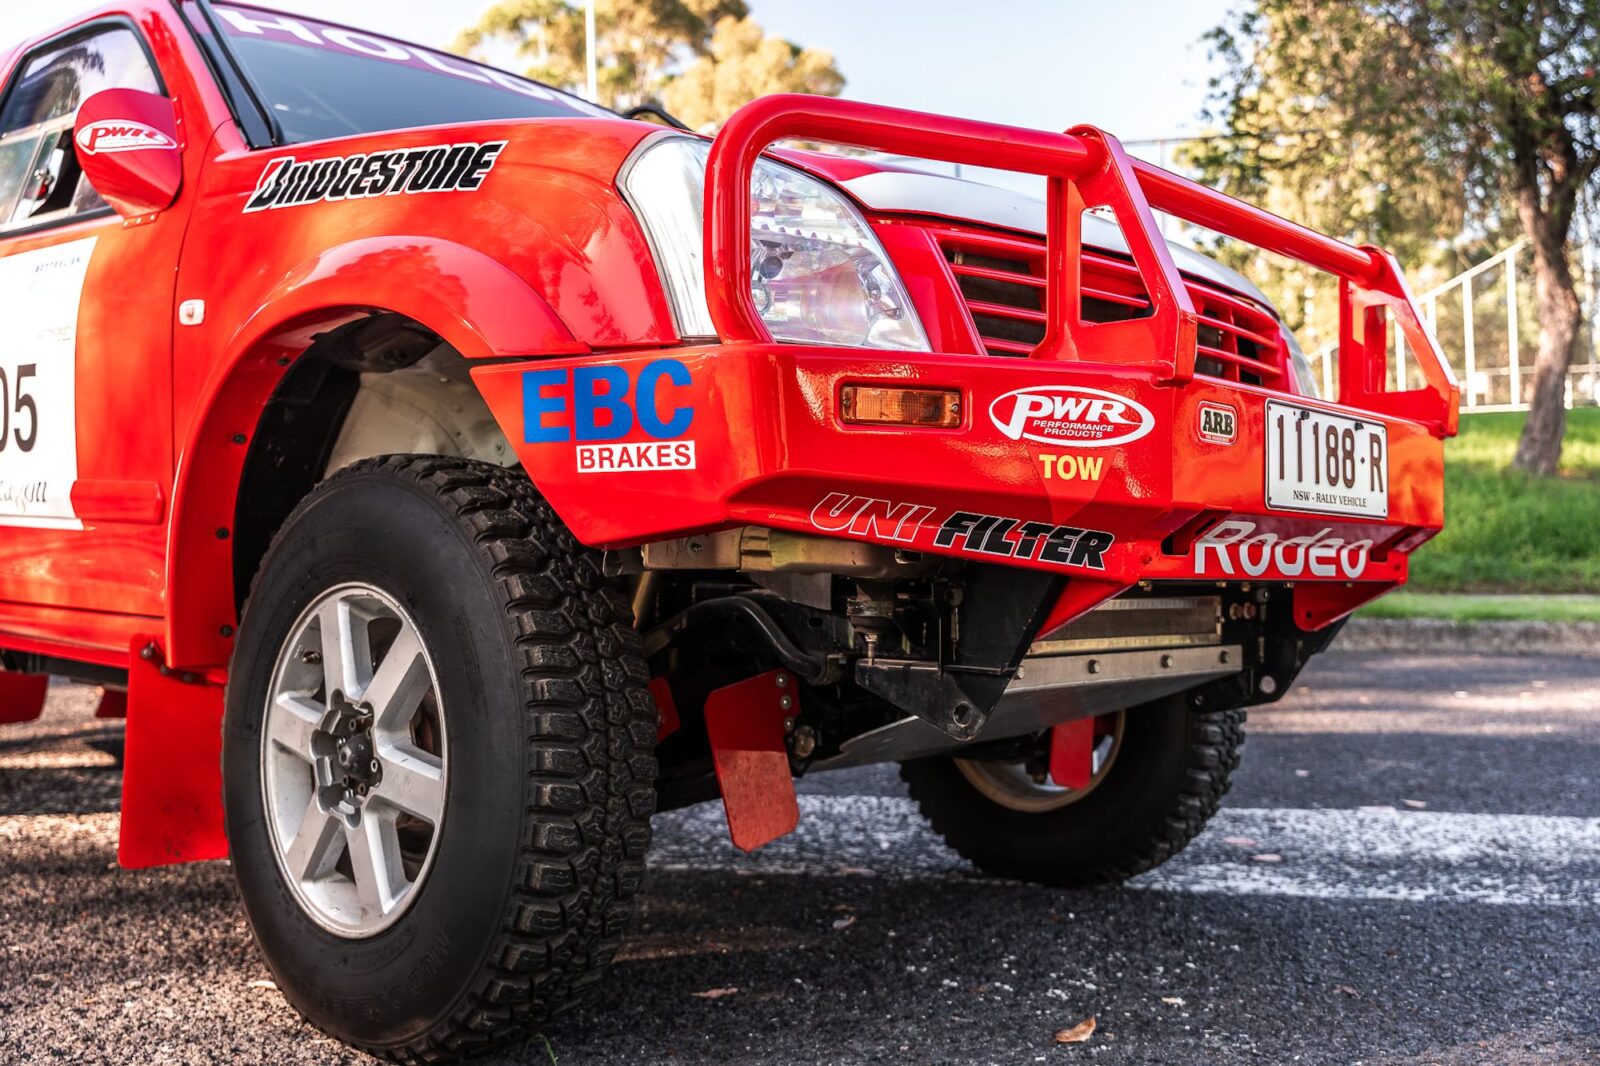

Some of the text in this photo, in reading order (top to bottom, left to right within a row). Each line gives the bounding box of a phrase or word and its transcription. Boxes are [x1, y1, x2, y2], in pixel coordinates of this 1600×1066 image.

[244, 141, 507, 212] BRIDGESTONE
[522, 358, 694, 443] EBC
[1006, 393, 1136, 440] PWR
[1032, 420, 1114, 432] PERFORMANCE
[1202, 409, 1234, 436] ARB
[1043, 428, 1103, 438] PRODUCTS
[579, 444, 691, 469] BRAKES
[1039, 453, 1104, 481] TOW
[1293, 490, 1311, 501] NSW
[1316, 492, 1337, 505] RALLY
[1338, 495, 1367, 508] VEHICLE
[810, 492, 1116, 570] UNI FILTER
[1194, 520, 1374, 579] Rodeo
